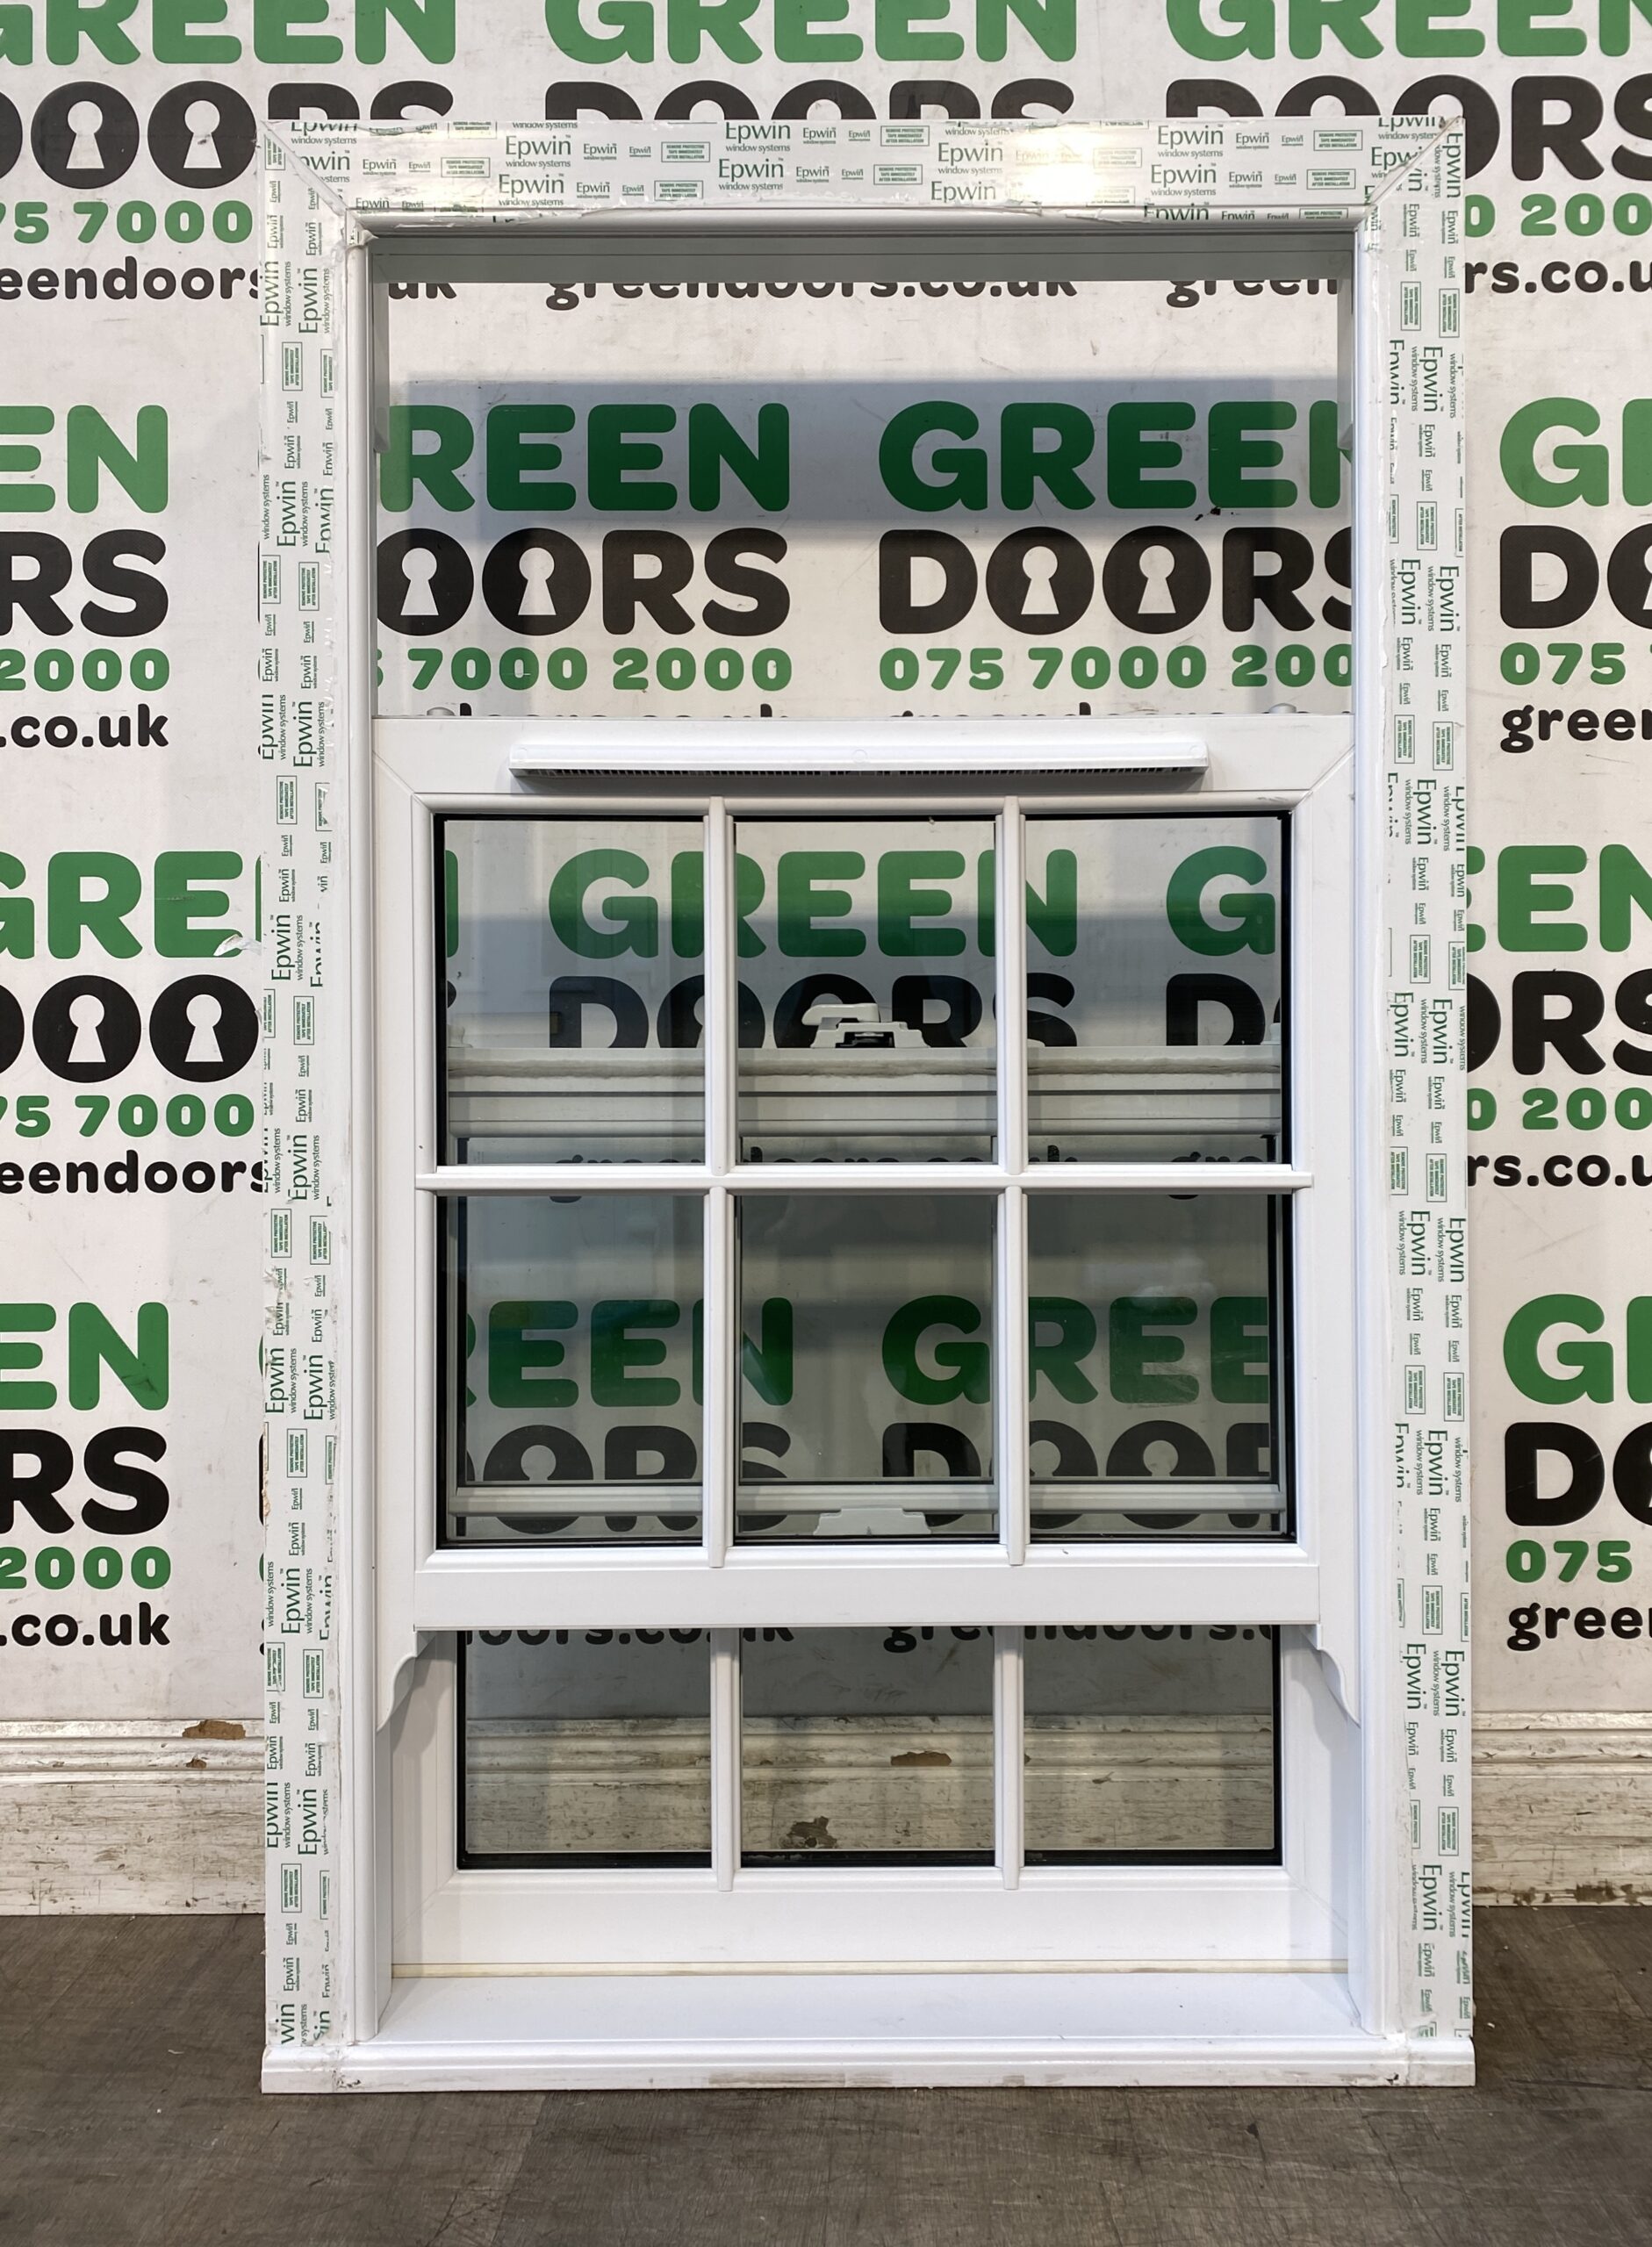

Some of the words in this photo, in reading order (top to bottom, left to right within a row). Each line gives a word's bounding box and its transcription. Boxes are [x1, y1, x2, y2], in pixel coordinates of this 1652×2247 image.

[0, 0, 456, 65] REEN
[545, 0, 1077, 64] GREEN
[1166, 0, 1652, 61] GREE
[291, 136, 324, 145] window
[325, 137, 357, 147] systems
[506, 134, 571, 157] Epwin
[726, 121, 790, 143] Epwin
[758, 145, 790, 154] systems
[803, 127, 837, 141] Epwin
[937, 140, 1003, 165] Epwin
[1158, 124, 1224, 148] Epwin
[1236, 133, 1269, 147] Epwin
[363, 158, 397, 172] Epwin
[718, 157, 784, 181] Epwin
[1151, 162, 1217, 187] Epwin
[1191, 150, 1224, 159] systems
[499, 173, 564, 197] Epwin
[576, 182, 610, 196] Epwin
[931, 181, 996, 203] Epwin
[1229, 171, 1262, 186] Epwin
[73, 199, 253, 244] 7000
[306, 222, 318, 255] Epwin
[1408, 204, 1419, 238] Epwin
[0, 255, 258, 302] eendoor
[260, 262, 284, 326] Epwin
[298, 268, 321, 334] Epwin
[1419, 346, 1443, 412] Epwin
[284, 435, 296, 469] Epwin
[380, 403, 790, 513] REEN
[1423, 424, 1435, 457] Epwin
[277, 481, 300, 546] Epwin
[0, 528, 169, 637] RS
[377, 528, 791, 636] OORS
[1397, 559, 1420, 625] Epwin
[1435, 566, 1459, 632] Epwin
[0, 648, 170, 692] 2000
[301, 656, 312, 689] Epwin
[407, 647, 588, 691] 7000
[613, 647, 792, 692] 2000
[880, 647, 1004, 692] 075
[1028, 645, 1207, 690] 7000
[1401, 637, 1413, 671] Epwin
[1500, 642, 1627, 686] 075
[293, 701, 317, 767] Epwin
[1413, 779, 1436, 845] Epwin
[279, 869, 291, 902] Epwin
[1417, 858, 1429, 891] Epwin
[549, 847, 1078, 959] GREEN
[271, 915, 295, 980] Epwin
[1390, 992, 1414, 1057] Epwin
[1429, 999, 1453, 1064] Epwin
[1394, 1069, 1406, 1102] Epwin
[75, 1094, 255, 1138] 7000
[288, 1135, 312, 1200] Epwin
[1407, 1210, 1430, 1275] Epwin
[312, 1310, 324, 1343] Epwin
[1411, 1289, 1423, 1321] Epwin
[1450, 1295, 1462, 1328] Epwin
[466, 1296, 794, 1409] EEN
[265, 1348, 289, 1413] Epwin
[304, 1355, 327, 1420] Epwin
[0, 1426, 170, 1535] RS
[1425, 1430, 1448, 1496] Epwin
[289, 1522, 301, 1556] Epwin
[0, 1546, 171, 1590] 2000
[1505, 1540, 1633, 1583] 075
[281, 1568, 305, 1633] Epwin
[1507, 1602, 1652, 1651] gree
[1403, 1644, 1426, 1710] Epwin
[1441, 1650, 1464, 1717] Epwin
[1407, 1722, 1419, 1755] Epwin
[1446, 1729, 1457, 1762] Epwin
[298, 1789, 321, 1855] Epwin
[1419, 1864, 1442, 1931] Epwin
[284, 1957, 296, 1992] Epwin
